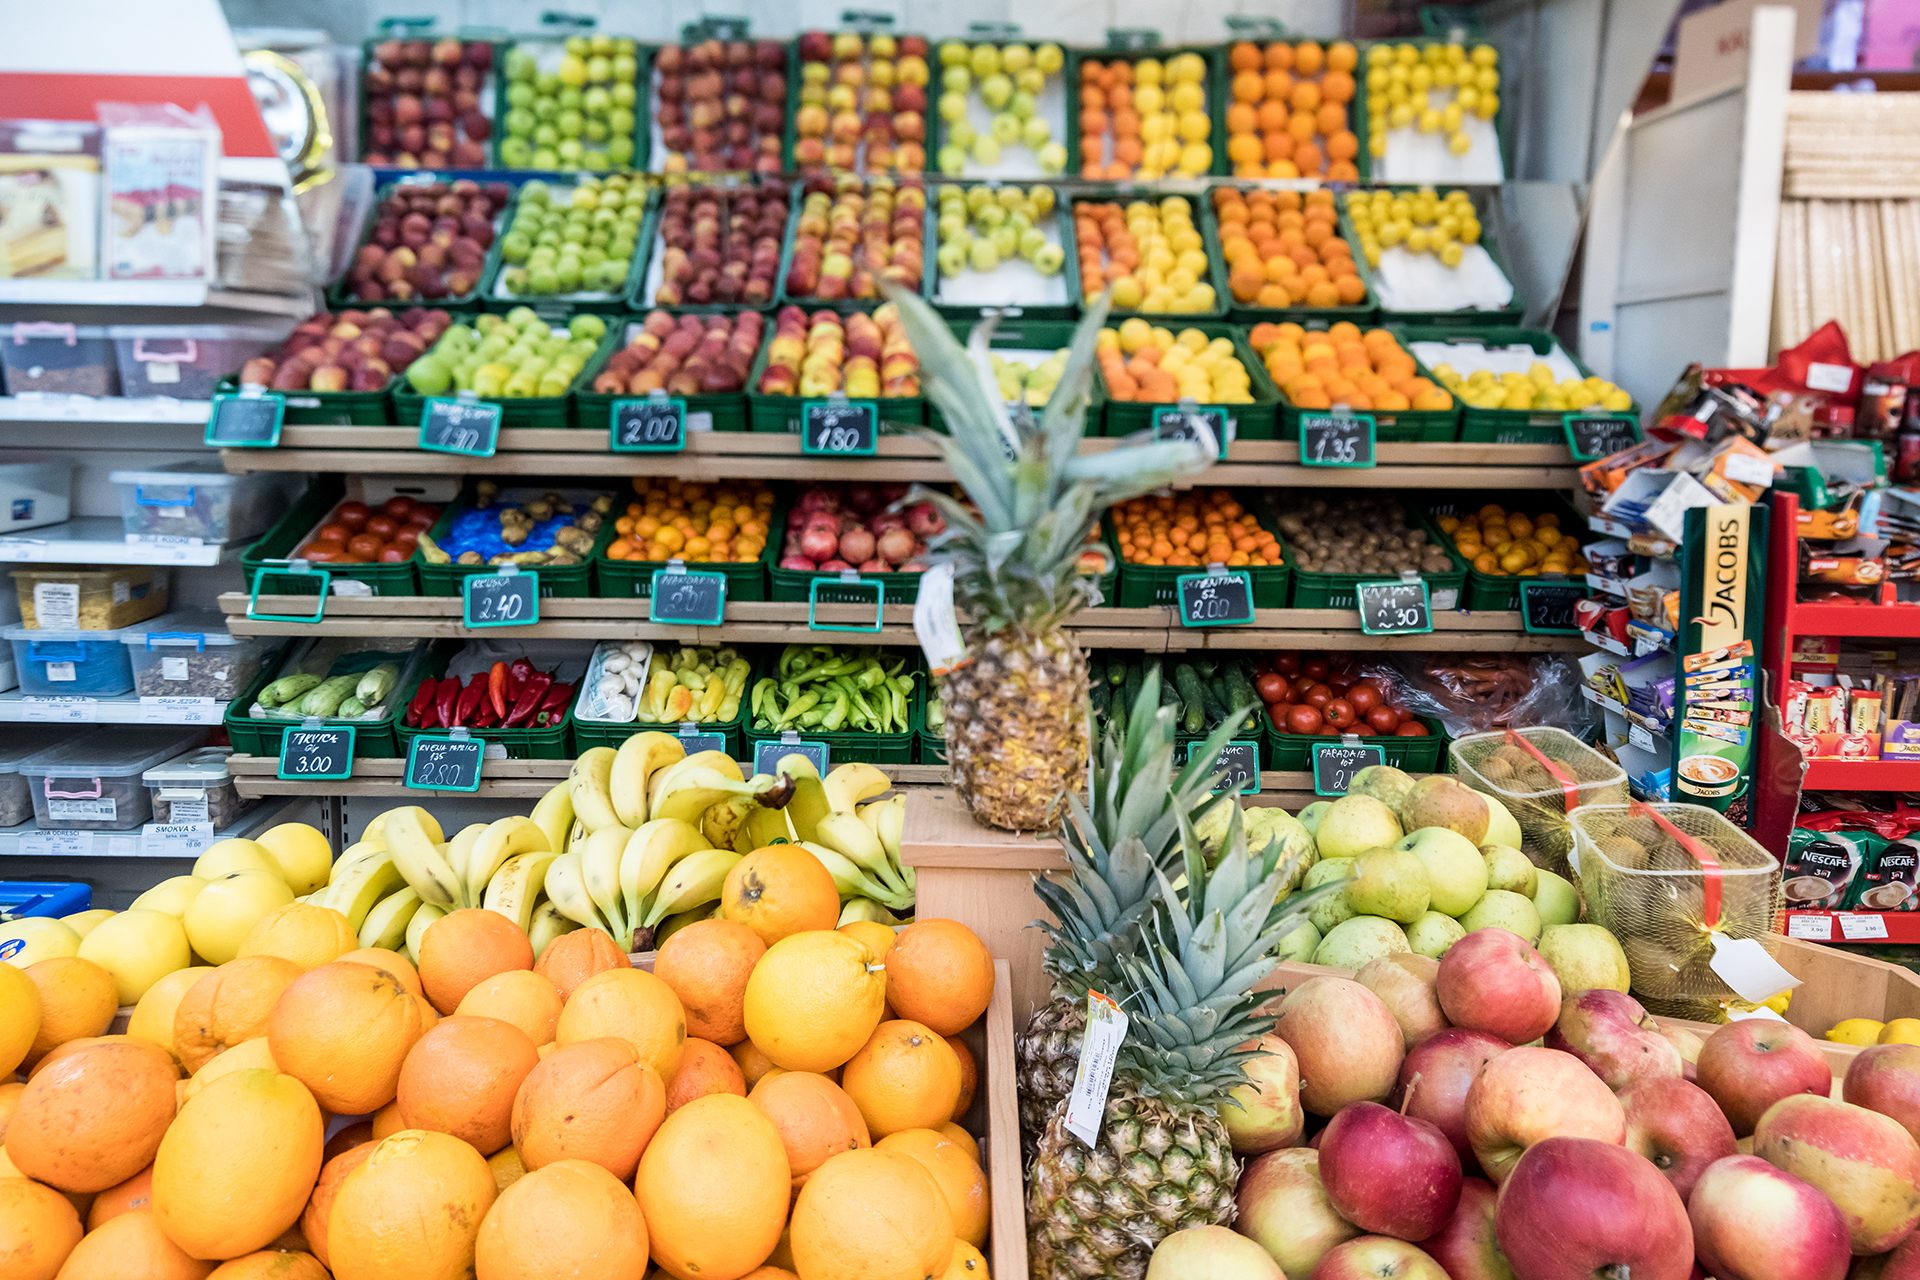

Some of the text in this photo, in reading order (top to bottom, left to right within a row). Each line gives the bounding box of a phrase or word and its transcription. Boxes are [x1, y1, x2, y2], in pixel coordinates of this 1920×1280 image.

[1708, 519, 1740, 630] JACOBS
[479, 593, 523, 621] 2.40
[296, 756, 332, 773] 3.00
[1694, 787, 1721, 796] JACOBS
[155, 825, 189, 833] SMOKVA
